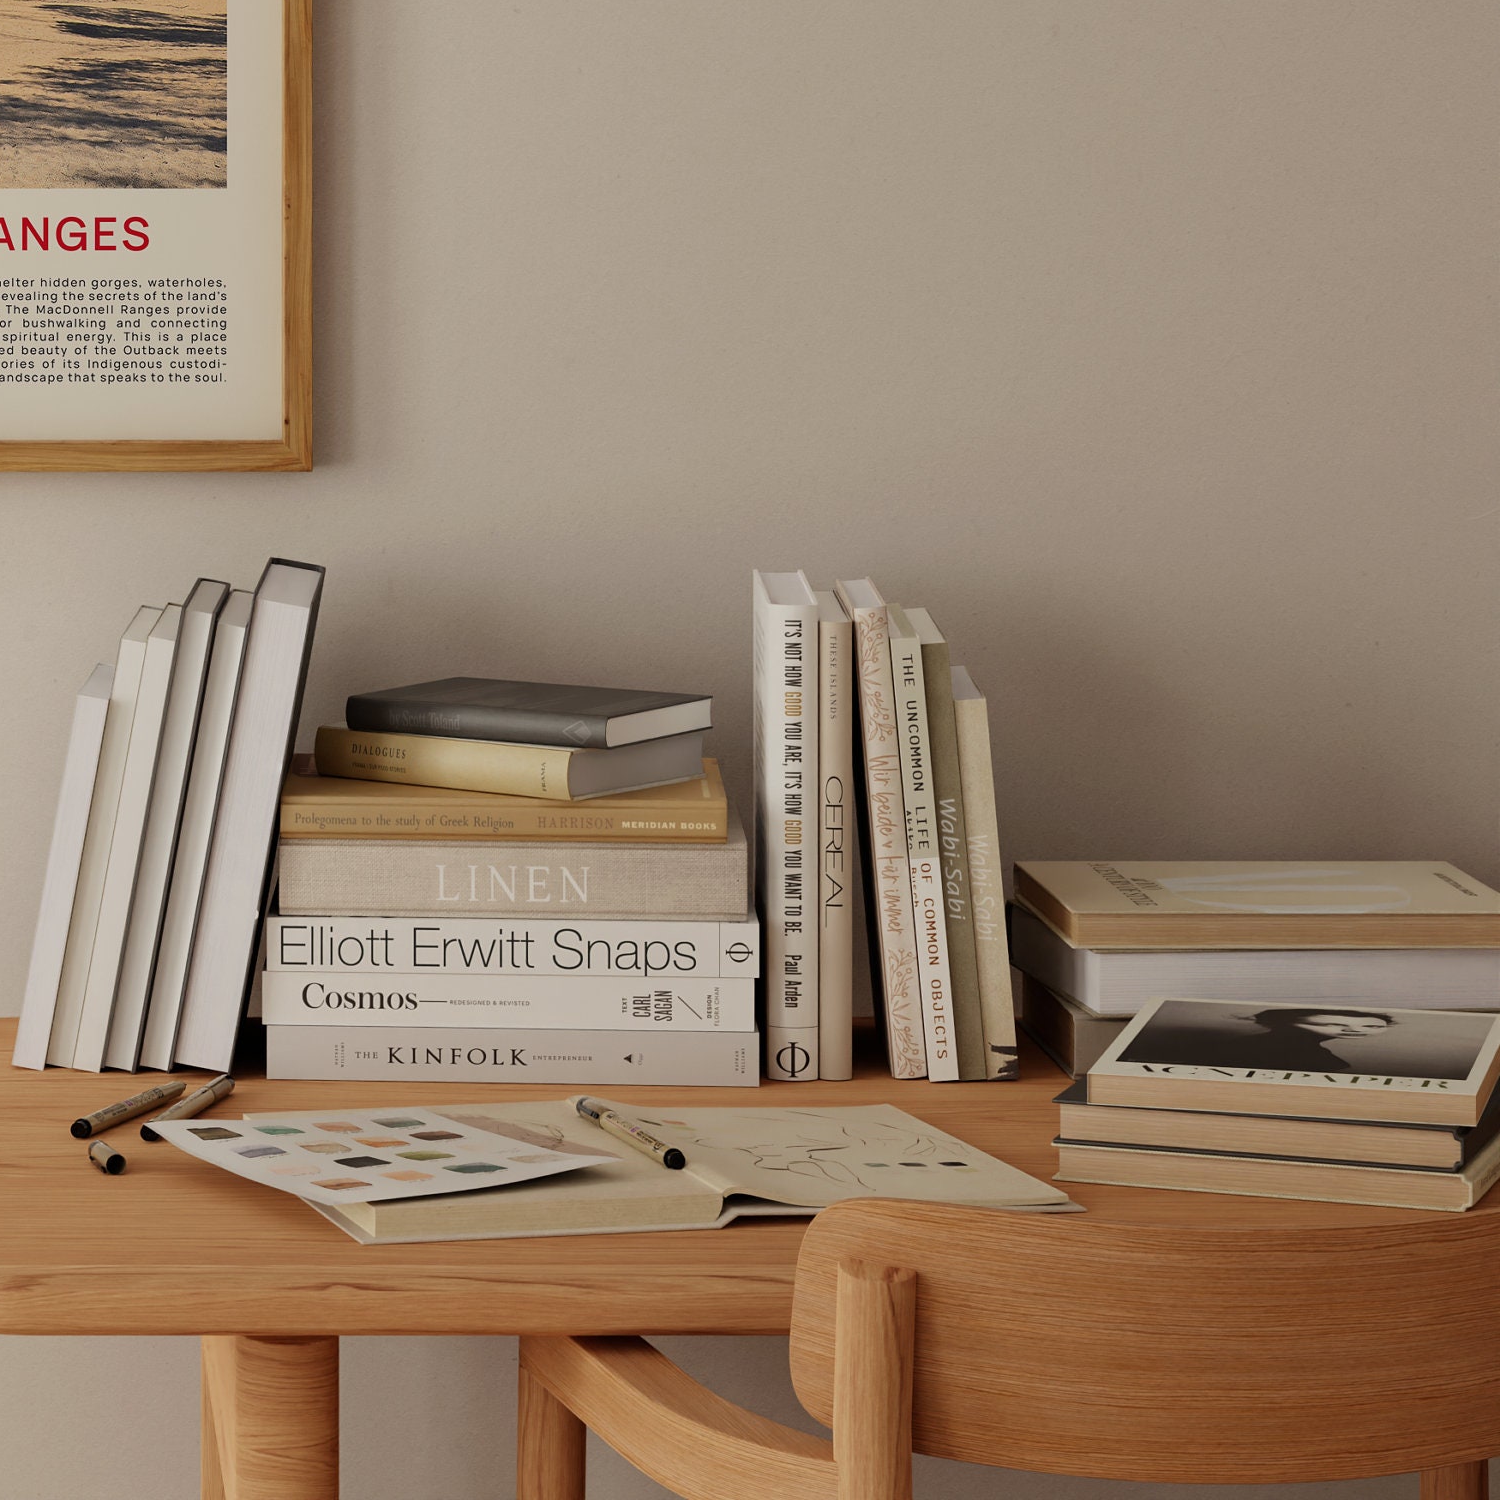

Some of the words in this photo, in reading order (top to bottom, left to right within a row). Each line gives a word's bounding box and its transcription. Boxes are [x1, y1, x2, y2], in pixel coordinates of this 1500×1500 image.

[41, 278, 85, 287] hidden
[92, 280, 141, 290] gorges,
[148, 278, 226, 287] waterholes,
[63, 292, 84, 300] the
[89, 292, 139, 300] secrets
[144, 291, 156, 300] of
[162, 292, 183, 300] the
[188, 292, 227, 300] land's
[784, 620, 802, 638] IT'S
[784, 642, 802, 661] NOT
[829, 635, 838, 669] THESE
[784, 666, 803, 688] HOW
[902, 653, 915, 687] THE
[784, 692, 802, 717] GOOD
[829, 673, 838, 720] ISLANDS
[784, 721, 802, 741] YOU
[351, 743, 407, 760] DIALOGUES
[782, 745, 802, 766] ARE,
[906, 700, 925, 792] UNCOMMON
[784, 771, 802, 790] IT'S
[869, 754, 898, 786] Wir
[784, 794, 803, 816] HOW
[872, 793, 897, 836] beide
[294, 812, 357, 829] Prolegomena
[362, 816, 372, 826] to
[376, 814, 392, 827] the
[395, 815, 421, 831] study
[425, 815, 437, 827] of
[439, 816, 469, 828] Greek
[473, 816, 515, 833] Religion
[537, 816, 615, 830] HARRISON
[621, 820, 677, 830] MERIDIAN
[680, 821, 717, 831] BOOKS
[784, 820, 802, 845] GOOD
[915, 805, 930, 850] LIFE
[784, 849, 802, 869] YOU
[824, 776, 844, 928] CEREAL
[939, 798, 966, 921] Wabi-Sabi
[435, 864, 592, 904] LINEN
[784, 872, 802, 899] WANT
[920, 862, 932, 885] OF
[967, 835, 998, 942] Wabi-Sabi
[784, 901, 802, 916] TO
[883, 889, 904, 936] immer
[784, 918, 802, 937] BE.
[923, 896, 940, 966] COMMON
[280, 925, 395, 968] Elliott
[413, 927, 535, 969] Erwitt
[553, 928, 697, 977] Snaps
[784, 953, 802, 977] Paul
[301, 982, 418, 1012] Cosmos
[632, 994, 651, 1017] CARL
[654, 991, 673, 1021] SAGAN
[784, 979, 803, 1008] Arden
[931, 978, 948, 1061] OBJECTS
[355, 1051, 379, 1059] THE
[386, 1046, 529, 1067] KINFOLK
